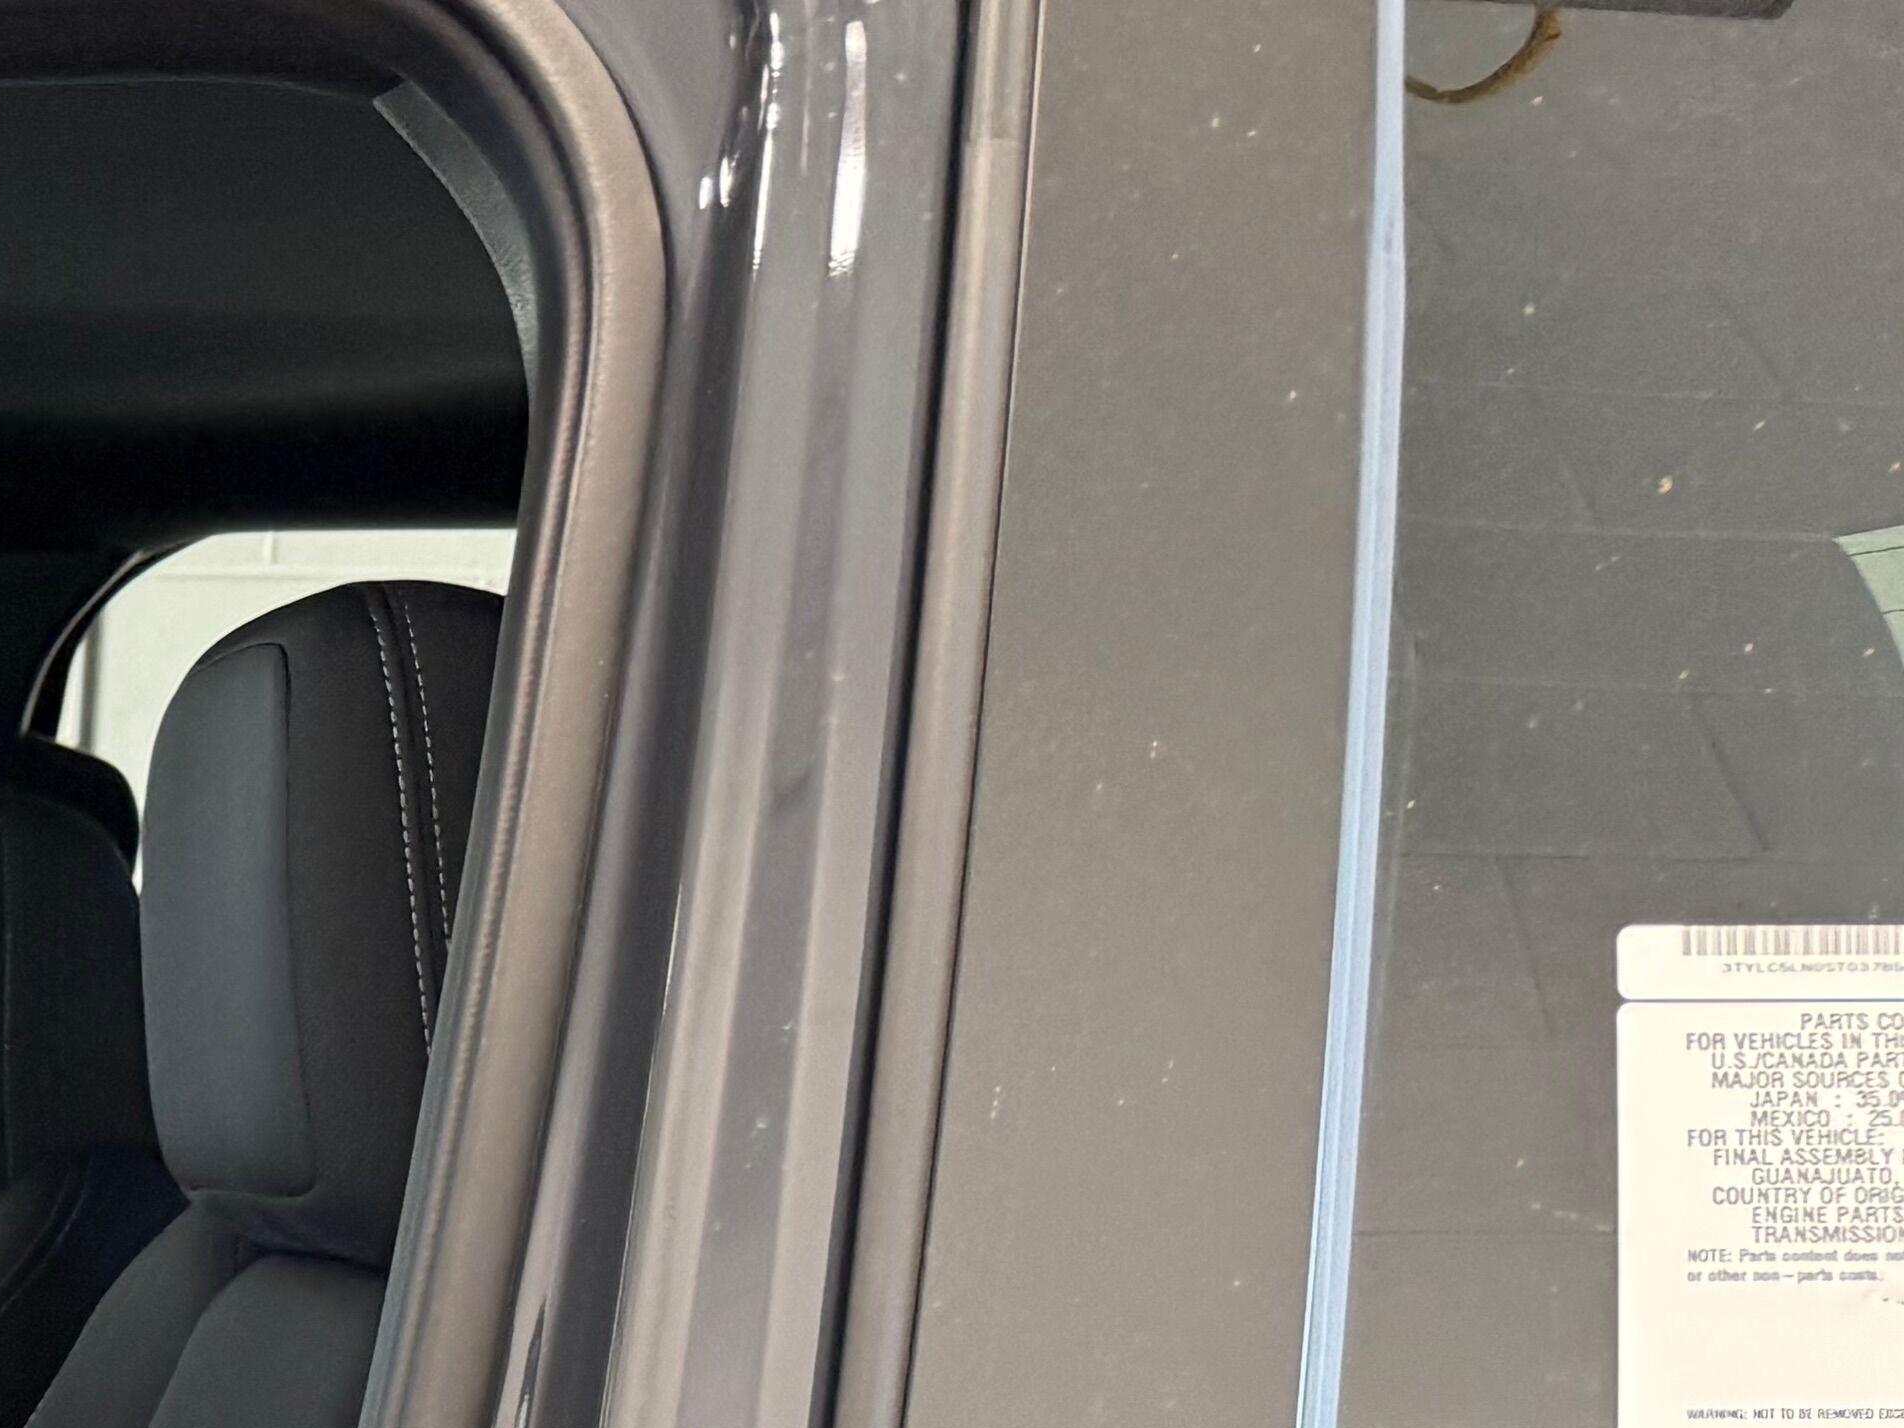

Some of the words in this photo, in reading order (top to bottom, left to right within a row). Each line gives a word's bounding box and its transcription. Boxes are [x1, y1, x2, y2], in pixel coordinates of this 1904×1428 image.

[1800, 1013, 1870, 1030] PARTS
[1686, 1032, 1726, 1050] FOR
[1733, 1032, 1833, 1050] VEHICLES
[1842, 1032, 1862, 1050] IN
[1711, 1071, 1784, 1089] MAJOR
[1792, 1071, 1890, 1088] SOURCES
[1750, 1091, 1818, 1108] JAPAN
[1750, 1110, 1831, 1127] MEXICO
[1687, 1129, 1727, 1147] FOR
[1734, 1129, 1783, 1146] THIS
[1791, 1128, 1885, 1146] VEHICLE:
[1713, 1148, 1774, 1166] FINAL
[1780, 1148, 1895, 1165] ASSEMBLY
[1751, 1167, 1900, 1187] GUANAJUATO,
[1711, 1187, 1812, 1205] COUNTRY
[1819, 1187, 1847, 1204] OF
[1751, 1206, 1828, 1224] ENGINE
[1687, 1249, 1733, 1262] NOTE:
[1687, 1271, 1702, 1282] or
[1708, 1268, 1747, 1282] other
[1752, 1408, 1776, 1420] NOT
[1780, 1408, 1795, 1420] TO
[1817, 1408, 1874, 1420] REMOVED
